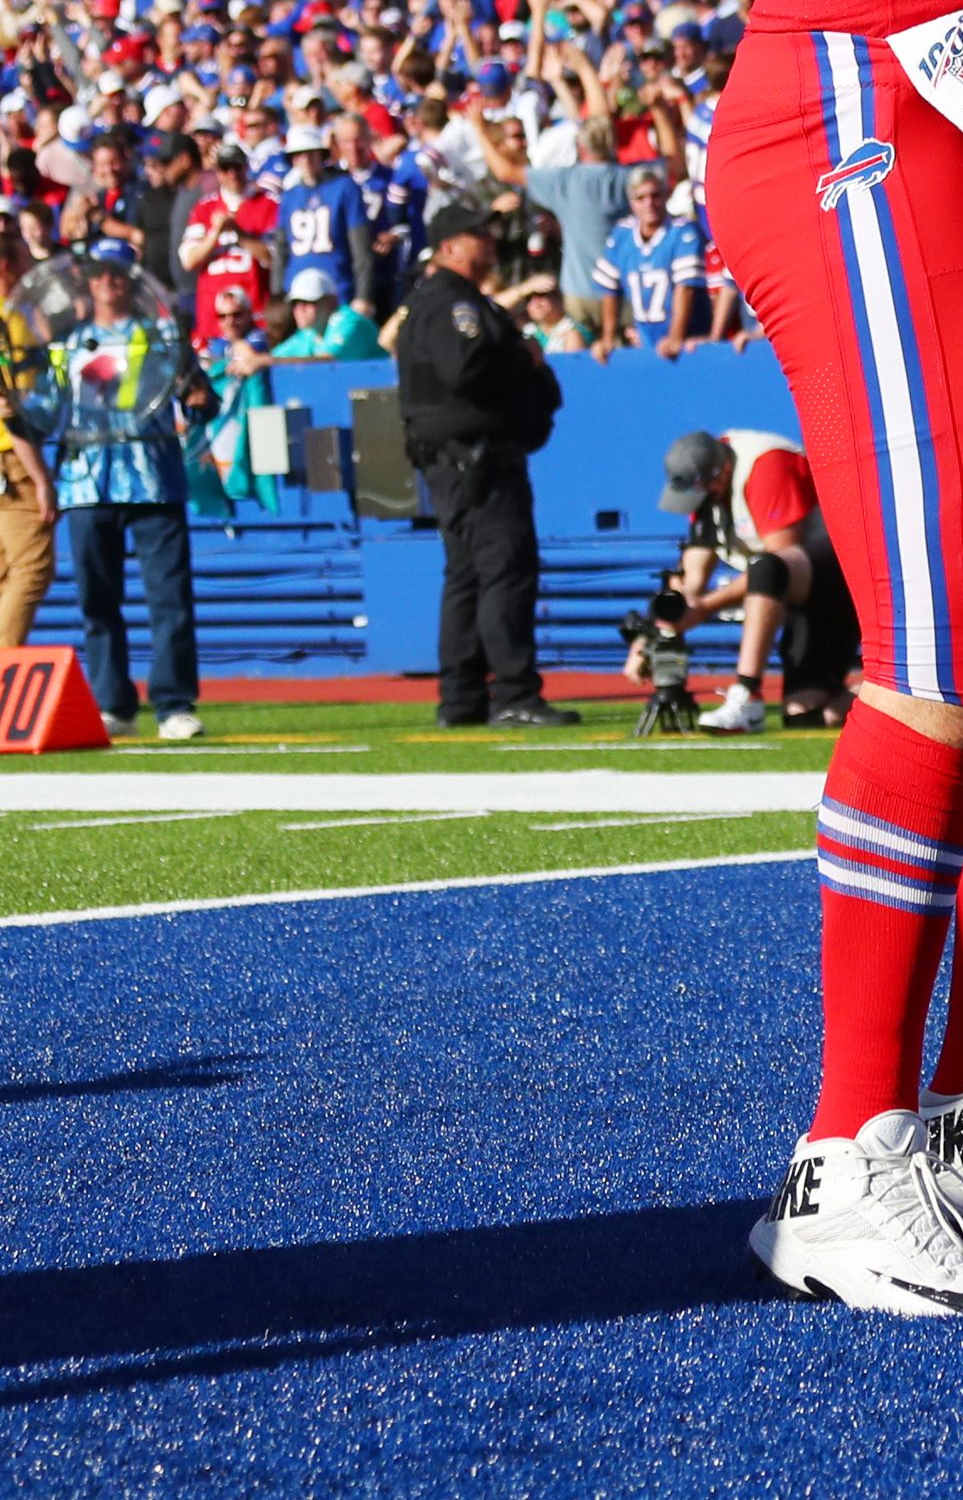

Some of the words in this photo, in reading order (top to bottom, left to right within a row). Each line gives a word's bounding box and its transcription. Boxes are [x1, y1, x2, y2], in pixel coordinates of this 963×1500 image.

[290, 205, 333, 257] 91
[627, 268, 669, 323] 17
[0, 662, 55, 742] 10
[768, 1156, 825, 1222] IKE
